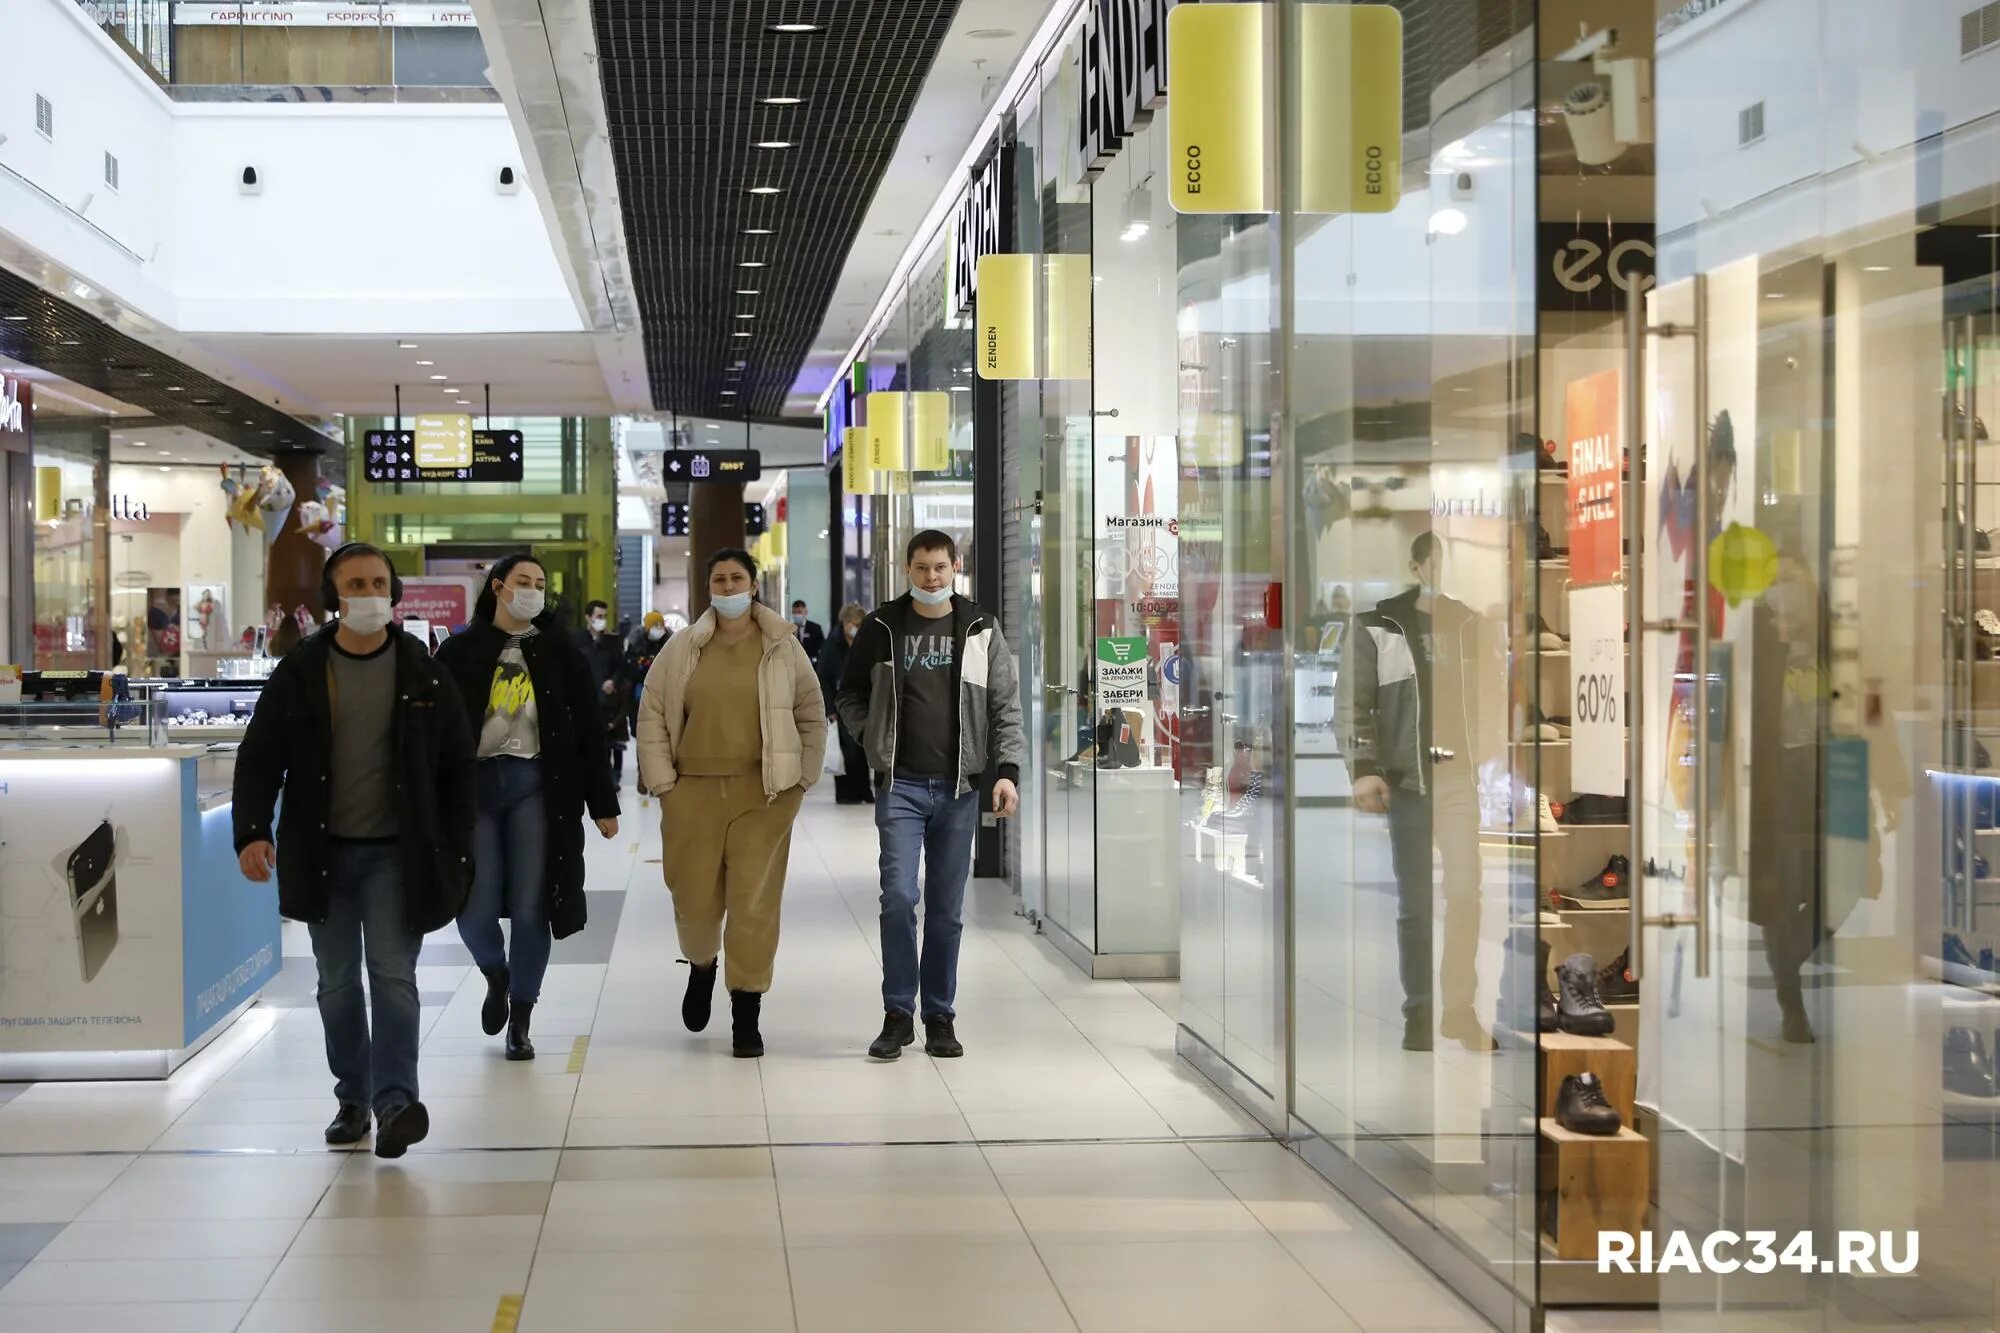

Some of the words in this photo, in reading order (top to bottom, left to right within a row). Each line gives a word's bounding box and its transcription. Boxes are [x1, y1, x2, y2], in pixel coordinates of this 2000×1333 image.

[1186, 144, 1201, 194] ECCO
[1365, 145, 1382, 195] ECCO
[987, 325, 998, 369] ZENDEN
[1572, 433, 1615, 478] FINAL
[1106, 516, 1163, 527] Магазин
[1578, 481, 1615, 524] SALE
[1102, 667, 1142, 675] ЗАКАЖИ
[1103, 690, 1143, 699] ЗАБЕРИ
[1577, 674, 1616, 723] 60%
[47, 1017, 88, 1025] ЗАЩИТА
[90, 1016, 142, 1025] ТЕЛЕФОНА
